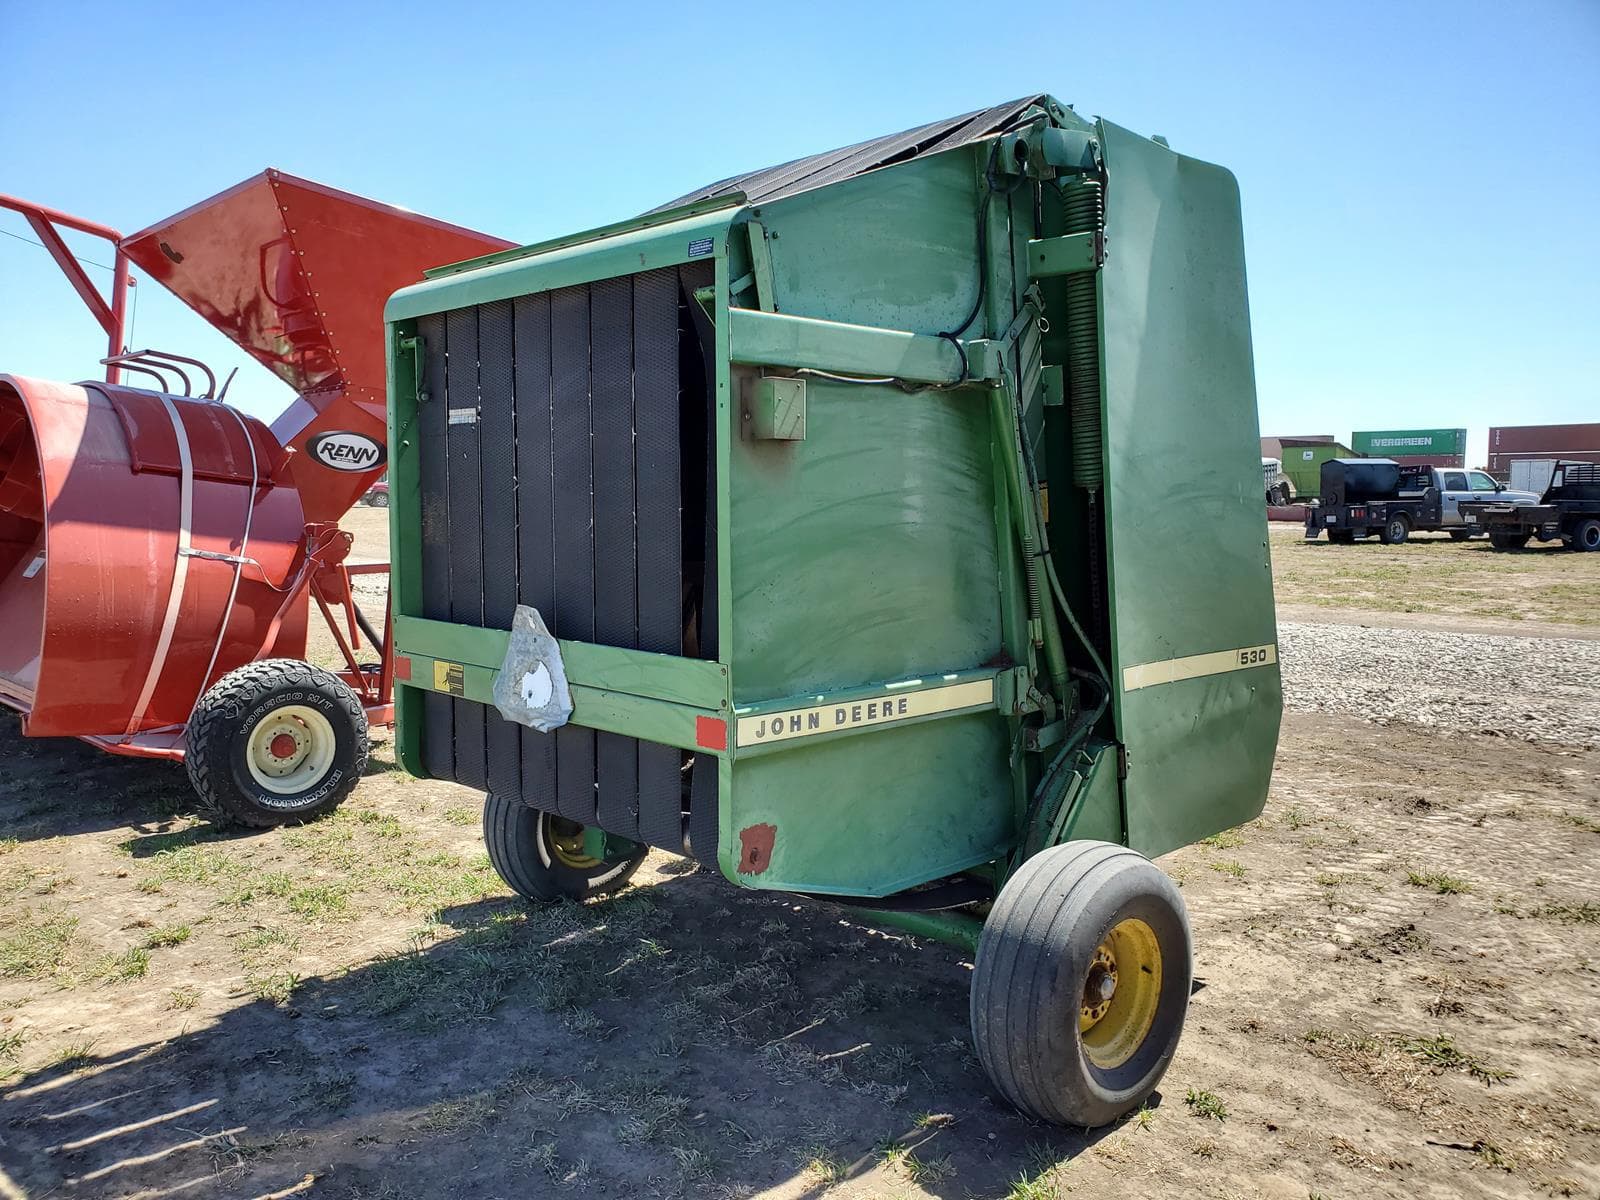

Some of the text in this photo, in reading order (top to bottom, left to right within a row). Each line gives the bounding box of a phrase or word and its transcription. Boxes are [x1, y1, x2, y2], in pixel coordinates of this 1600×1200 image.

[319, 441, 377, 464] RENN
[1370, 436, 1433, 448] EVERGREEN
[1240, 648, 1267, 666] 530
[239, 691, 334, 736] VORACIO M/T
[755, 697, 908, 739] JOHN DEERE
